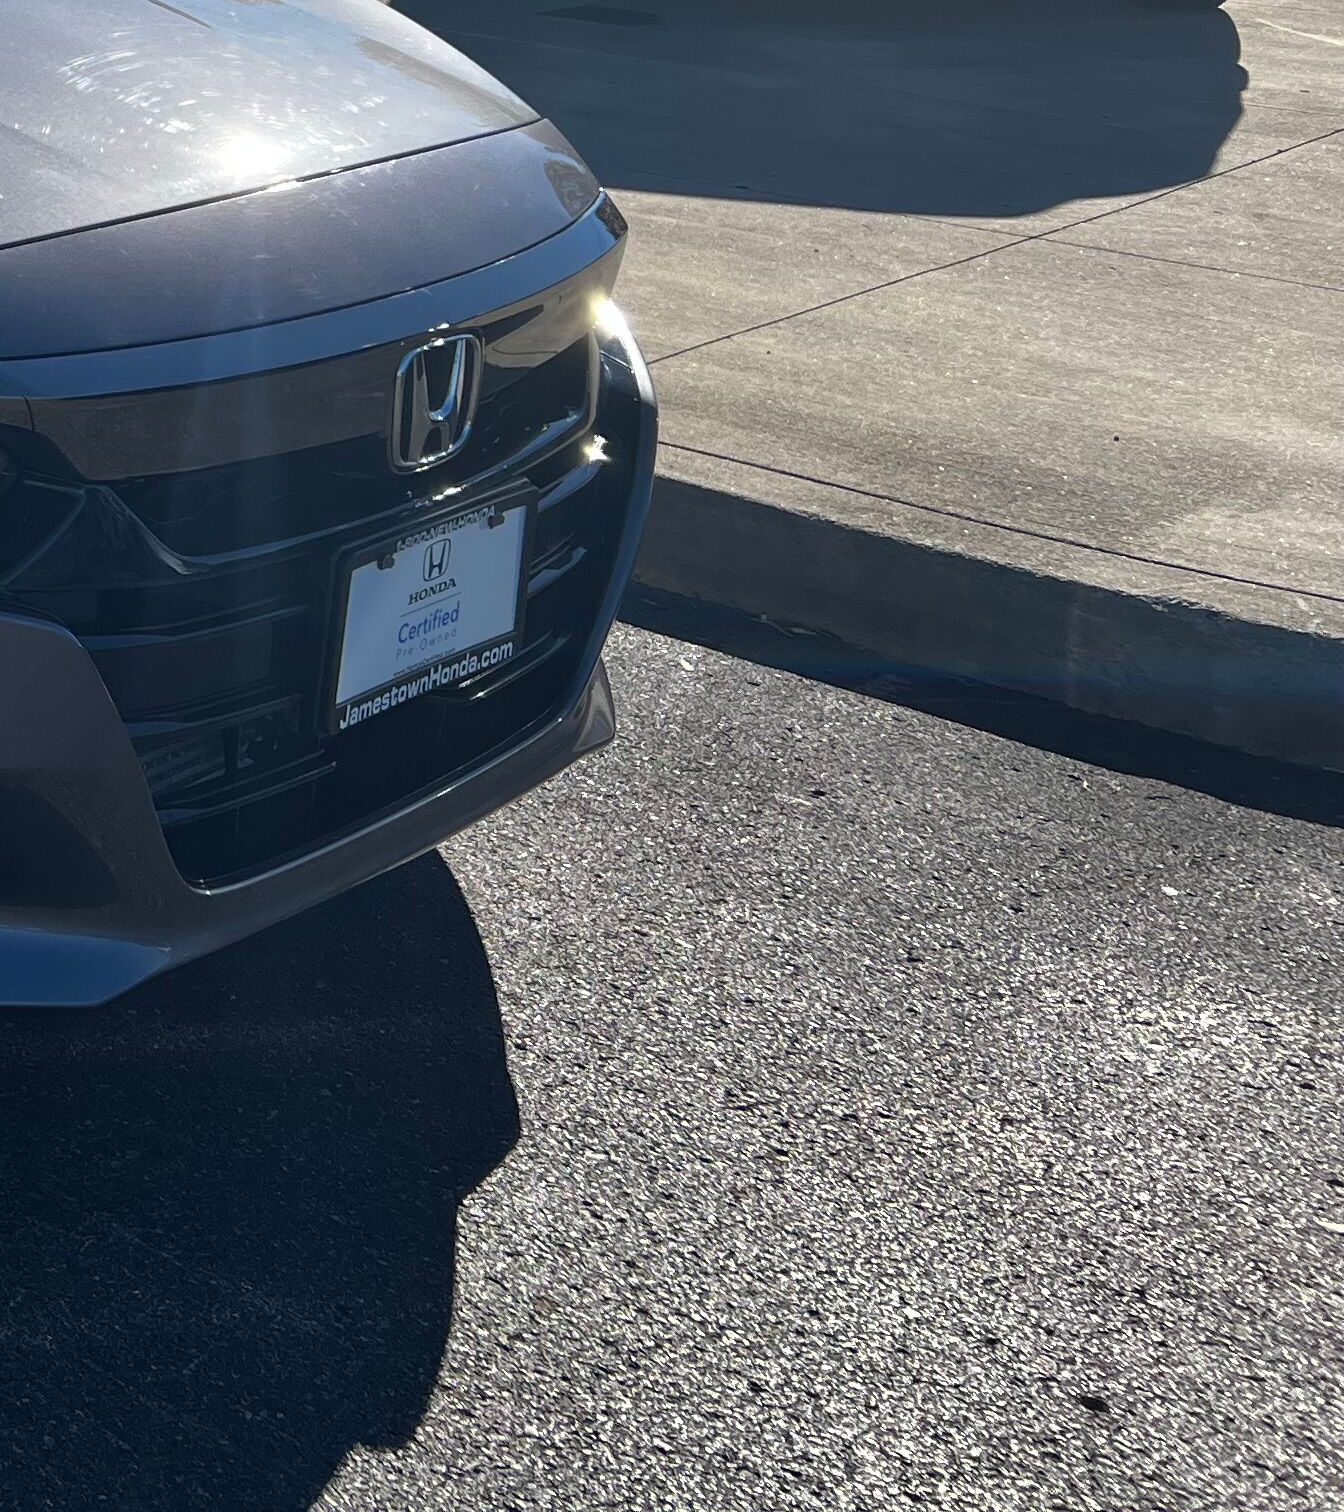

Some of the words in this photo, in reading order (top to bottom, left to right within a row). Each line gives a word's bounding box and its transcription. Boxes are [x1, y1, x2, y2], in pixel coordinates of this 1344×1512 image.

[408, 578, 457, 605] HONDA
[398, 600, 461, 644] Certified
[396, 628, 457, 660] Pre-Owned
[340, 641, 513, 730] JamestownHonda.com
